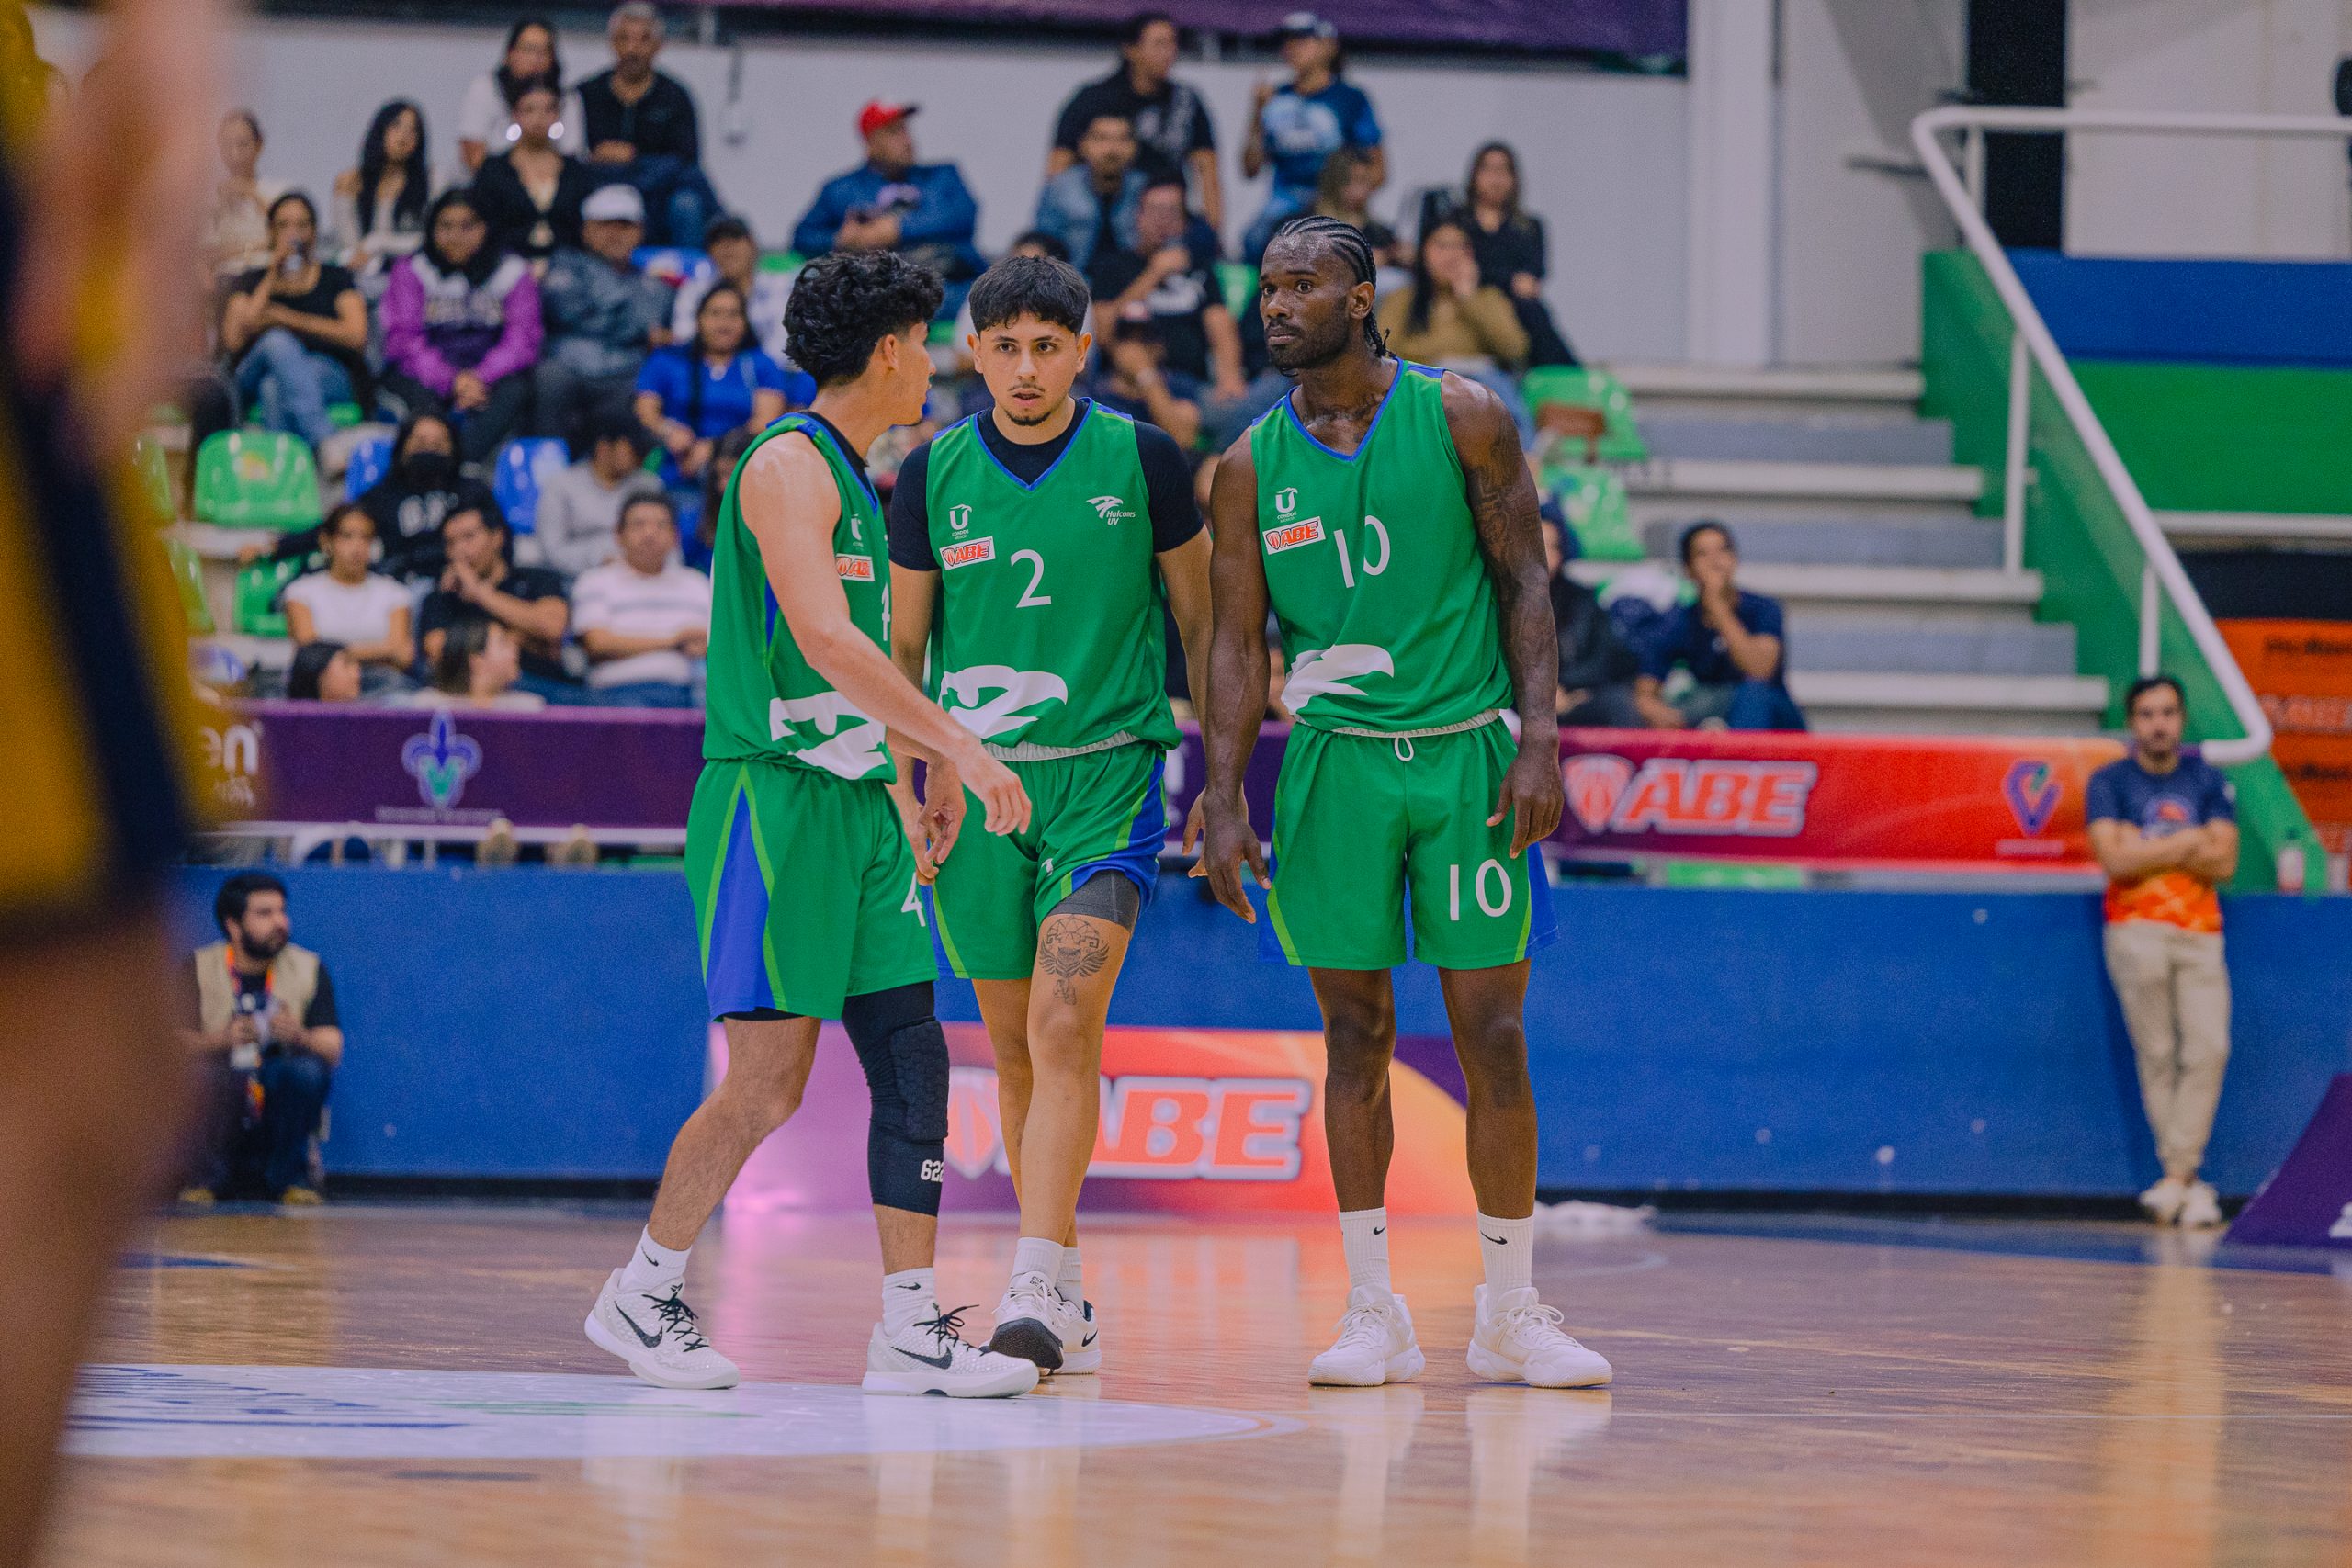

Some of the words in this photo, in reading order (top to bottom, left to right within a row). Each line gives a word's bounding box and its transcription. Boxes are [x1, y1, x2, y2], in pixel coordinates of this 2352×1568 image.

[955, 540, 990, 565] ABE
[1280, 521, 1318, 547] ABE
[1333, 514, 1391, 588] 10
[1010, 548, 1052, 608] 2
[1615, 761, 1814, 835] ABE
[901, 872, 926, 927] 4
[1449, 858, 1513, 921] 10
[1084, 1076, 1312, 1179] BE
